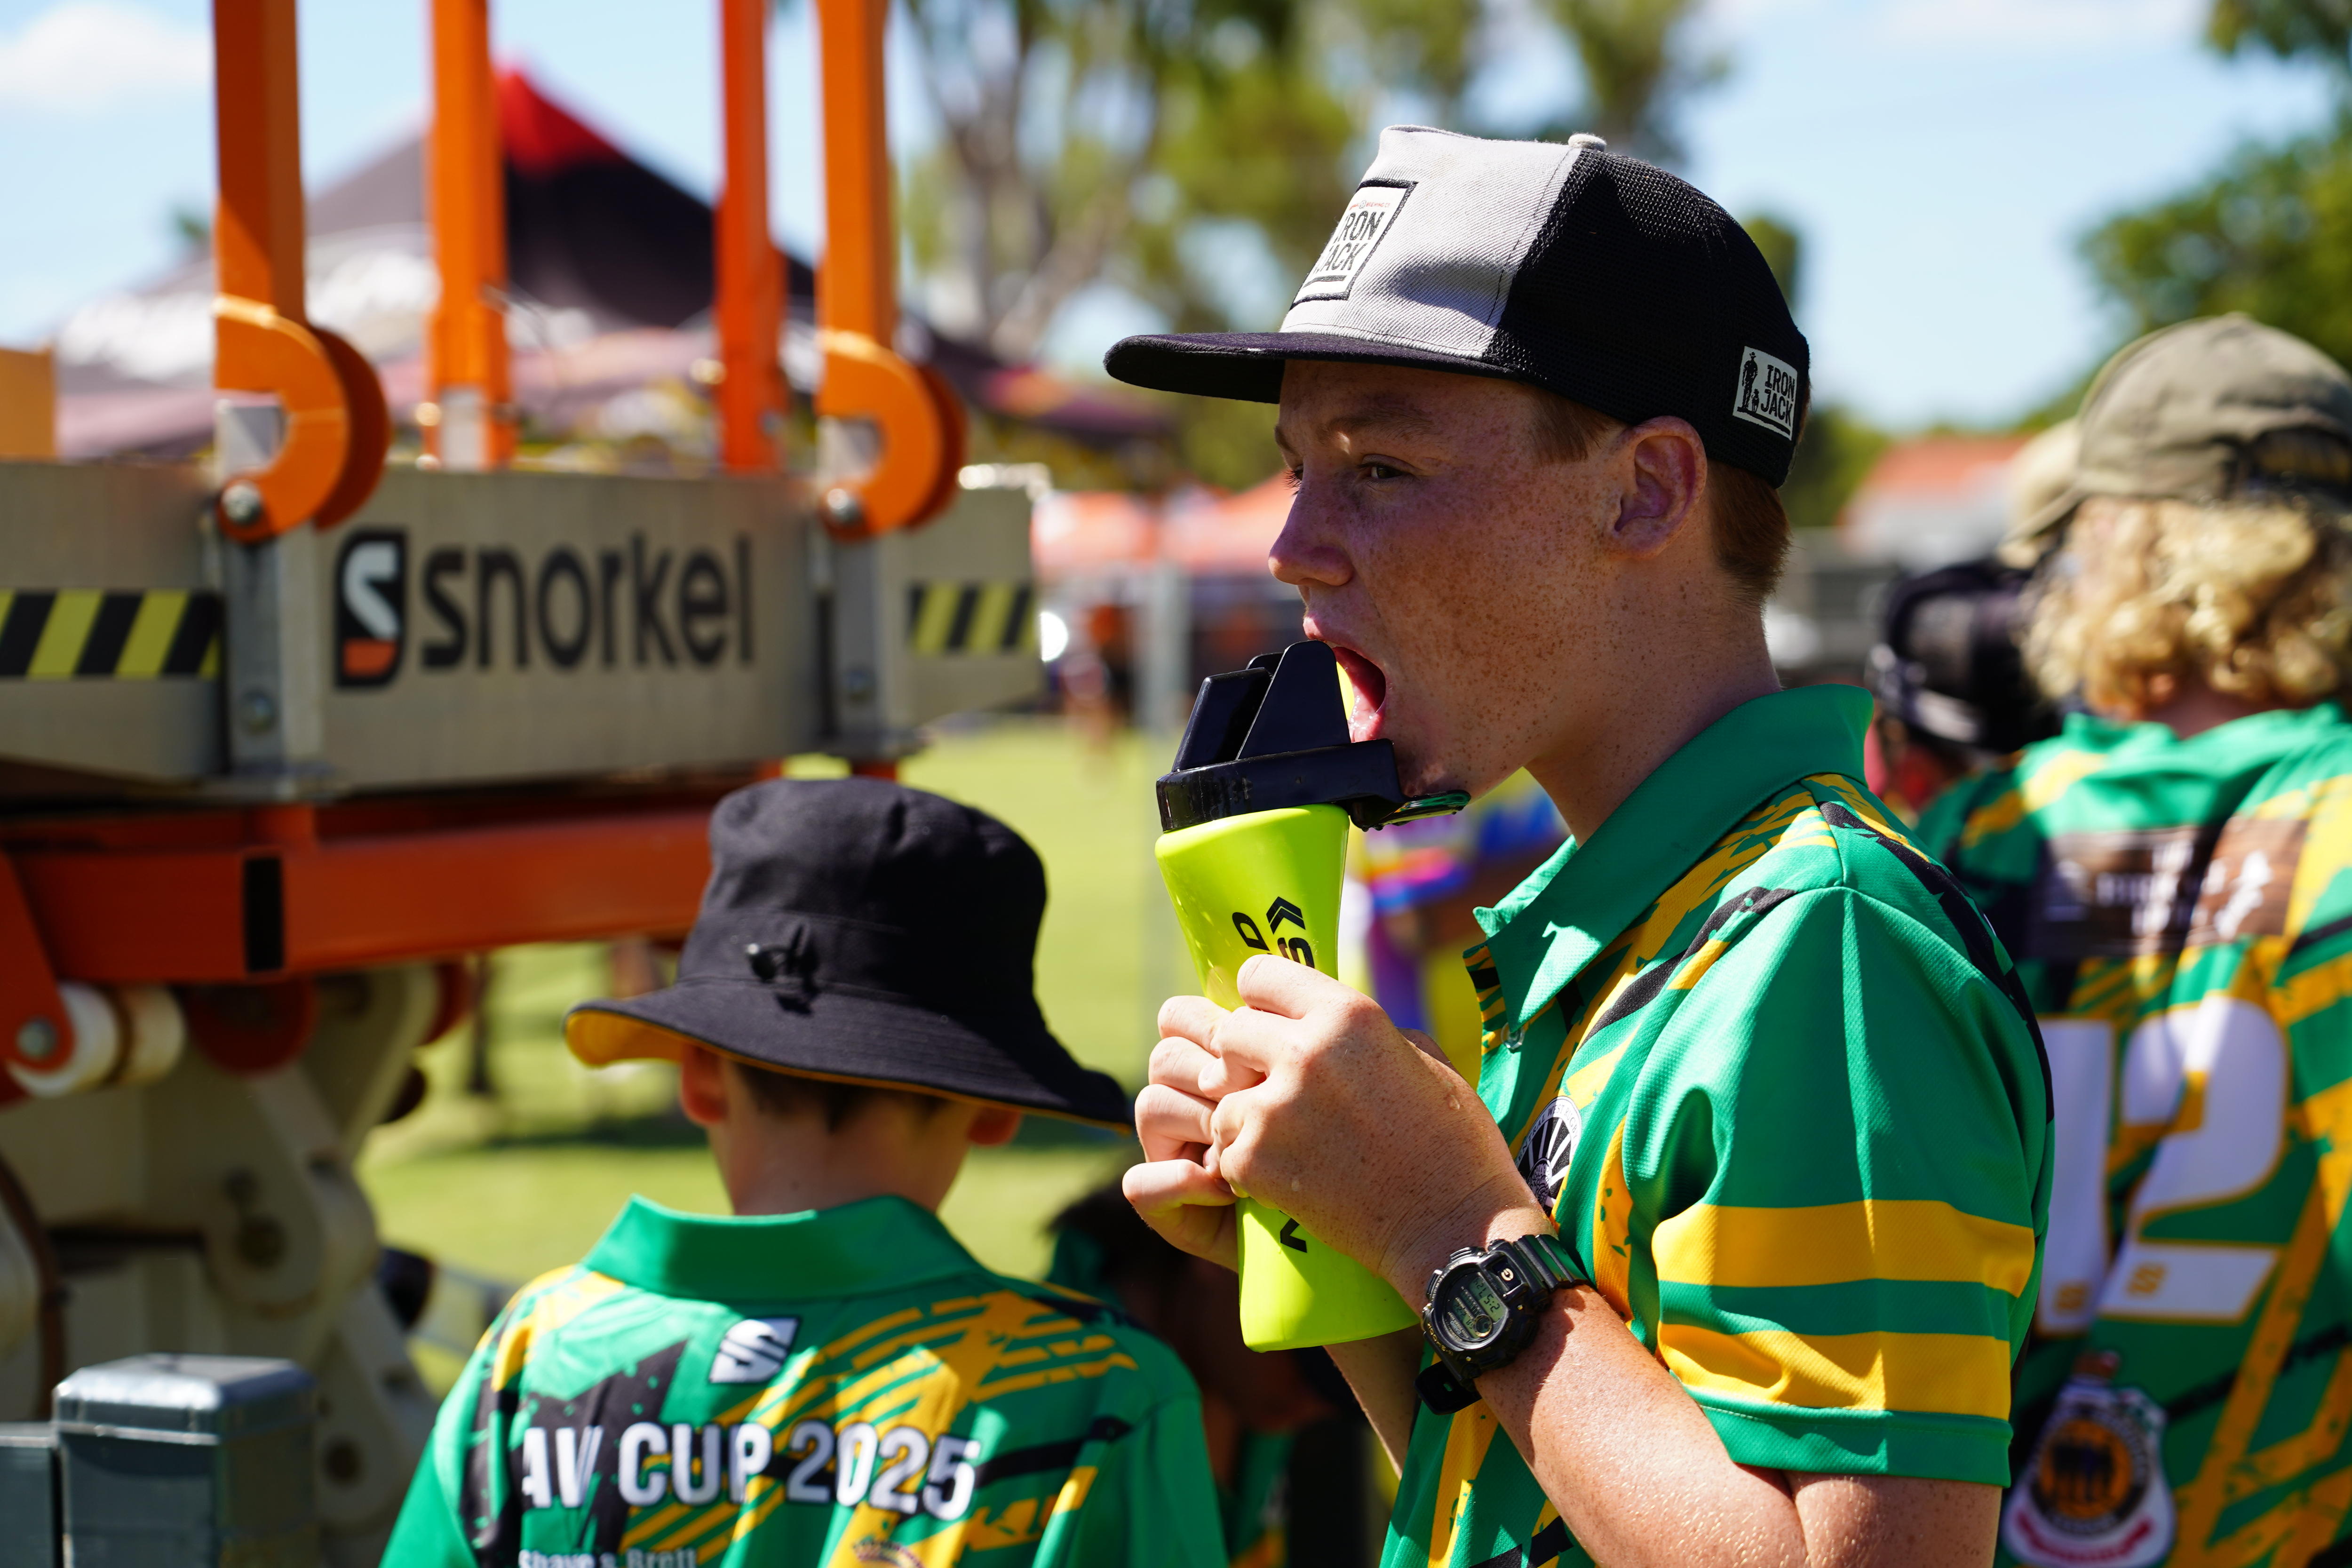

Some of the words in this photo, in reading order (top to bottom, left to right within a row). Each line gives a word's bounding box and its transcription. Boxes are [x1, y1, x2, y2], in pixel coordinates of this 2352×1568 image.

[1333, 210, 1385, 244] RON
[1764, 364, 1795, 402] IRON
[1761, 389, 1793, 427] JACK
[420, 530, 754, 672] snorkel
[1547, 1105, 1565, 1117] WEST
[1449, 1320, 1461, 1335] CASIO
[619, 1421, 773, 1505] CUP
[786, 1420, 981, 1520] 2025
